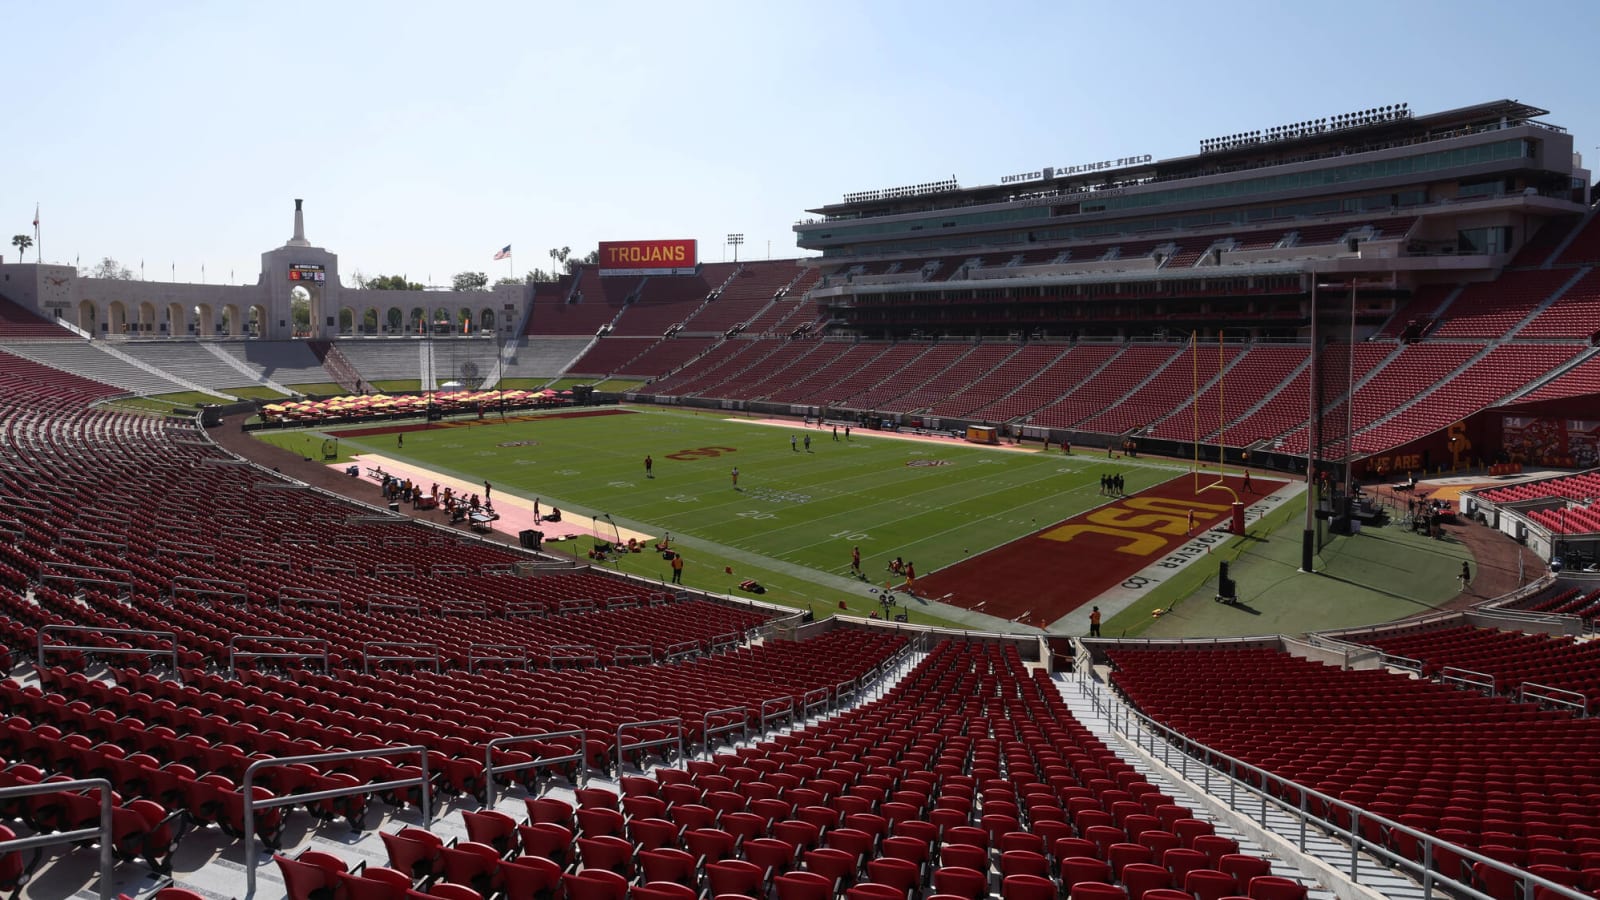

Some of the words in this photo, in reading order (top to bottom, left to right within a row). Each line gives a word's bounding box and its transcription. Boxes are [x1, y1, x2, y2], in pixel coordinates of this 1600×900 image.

[1001, 171, 1041, 183] UNITED
[1055, 160, 1111, 176] AIRLINES
[1117, 154, 1152, 167] FIELD
[608, 245, 685, 262] TROJANS
[1394, 454, 1420, 470] ARE
[1039, 496, 1234, 556] USC
[1157, 532, 1224, 569] FOREVER
